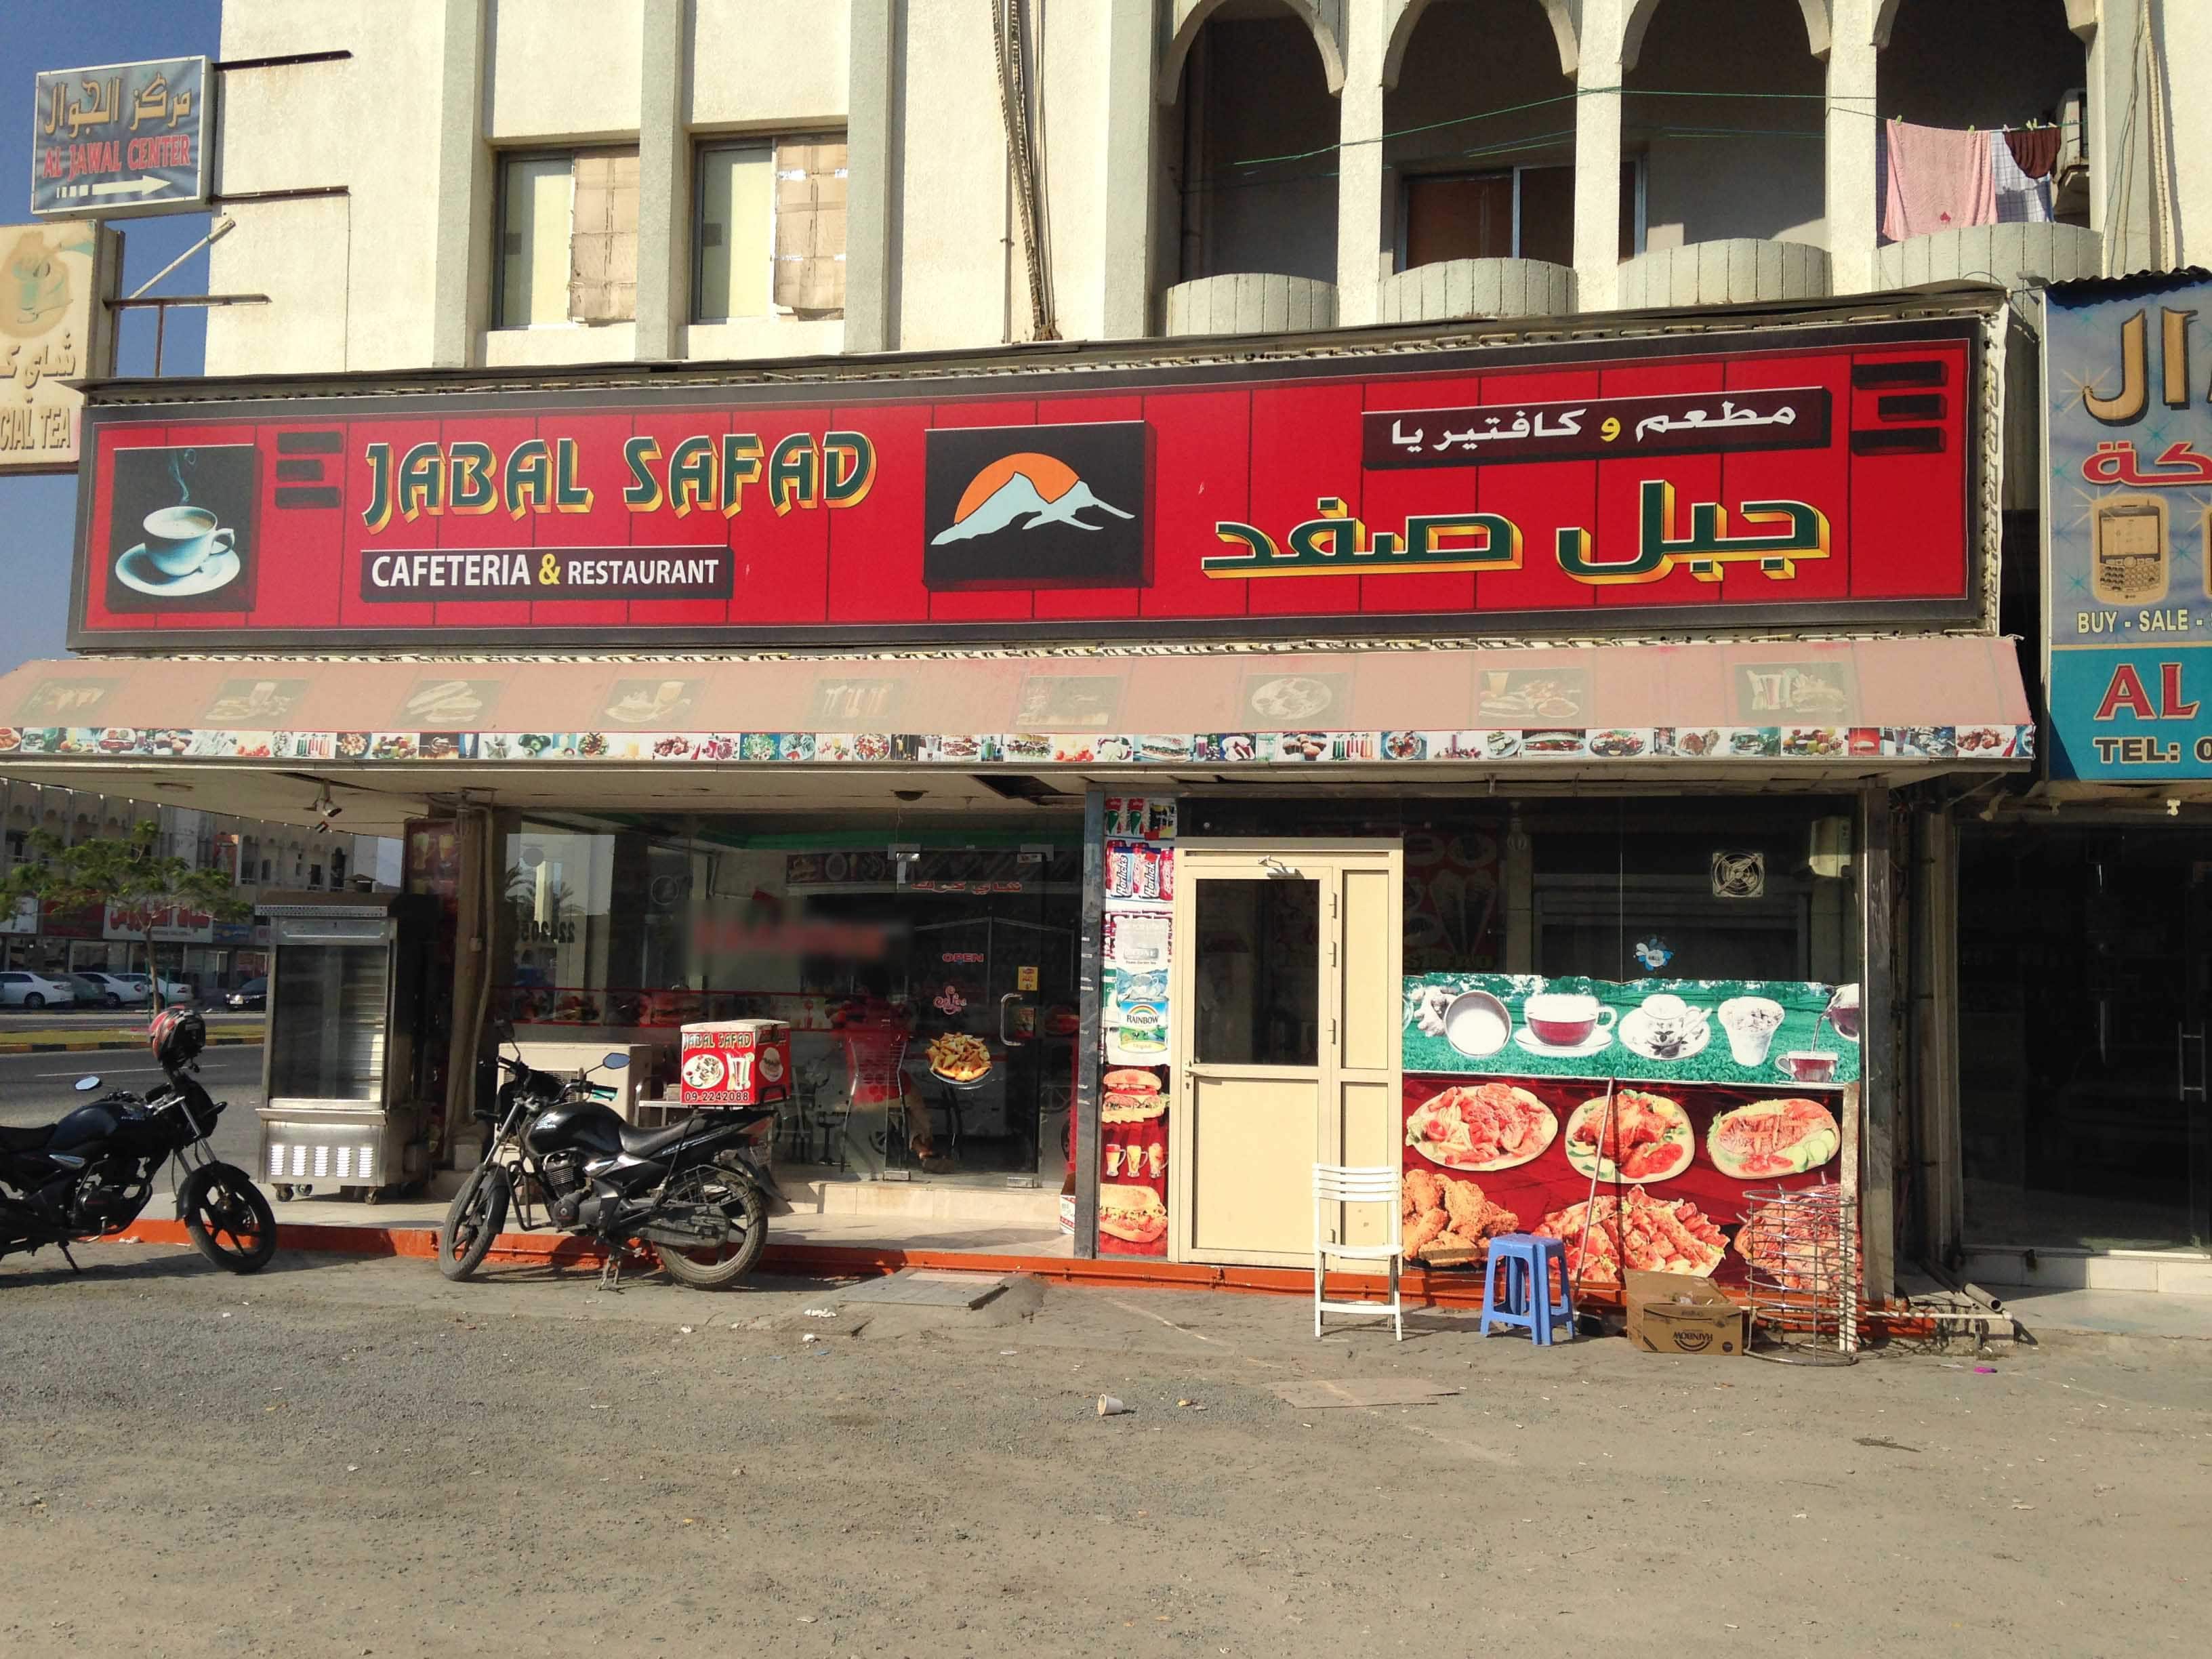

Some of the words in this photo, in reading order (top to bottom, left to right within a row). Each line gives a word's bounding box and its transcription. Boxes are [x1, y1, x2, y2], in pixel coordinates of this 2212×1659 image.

[44, 77, 122, 138] الجوال
[129, 70, 192, 131] مركز
[43, 146, 63, 178] AL
[68, 140, 122, 182] JAWAL
[127, 134, 191, 171] CENTER
[41, 406, 70, 449] TEA
[1391, 408, 1586, 454] كافتيريا
[1600, 417, 1620, 441] و
[1635, 400, 1796, 443] مطعم
[361, 437, 594, 535] JABAL
[623, 431, 877, 520] SAFAD
[1201, 497, 1523, 581] صفد
[1555, 479, 1830, 586] جبل
[372, 554, 530, 587] CAFETERIA
[539, 553, 560, 585] &
[568, 559, 719, 585] RESTAURANT
[2077, 611, 2118, 634] BUY
[2139, 609, 2188, 632] SALE
[2093, 662, 2200, 720] AL
[2093, 737, 2180, 763] TEL:
[1115, 855, 1128, 897] Horlicks
[1143, 862, 1156, 897] Horlick
[942, 953, 984, 962] OPEN
[1126, 1015, 1159, 1024] RAINBOW
[683, 1033, 715, 1052] JABAL
[718, 1033, 752, 1049] SAFAD
[685, 1090, 750, 1101] 09-2242088
[1673, 1332, 1713, 1341] RAINBOW
